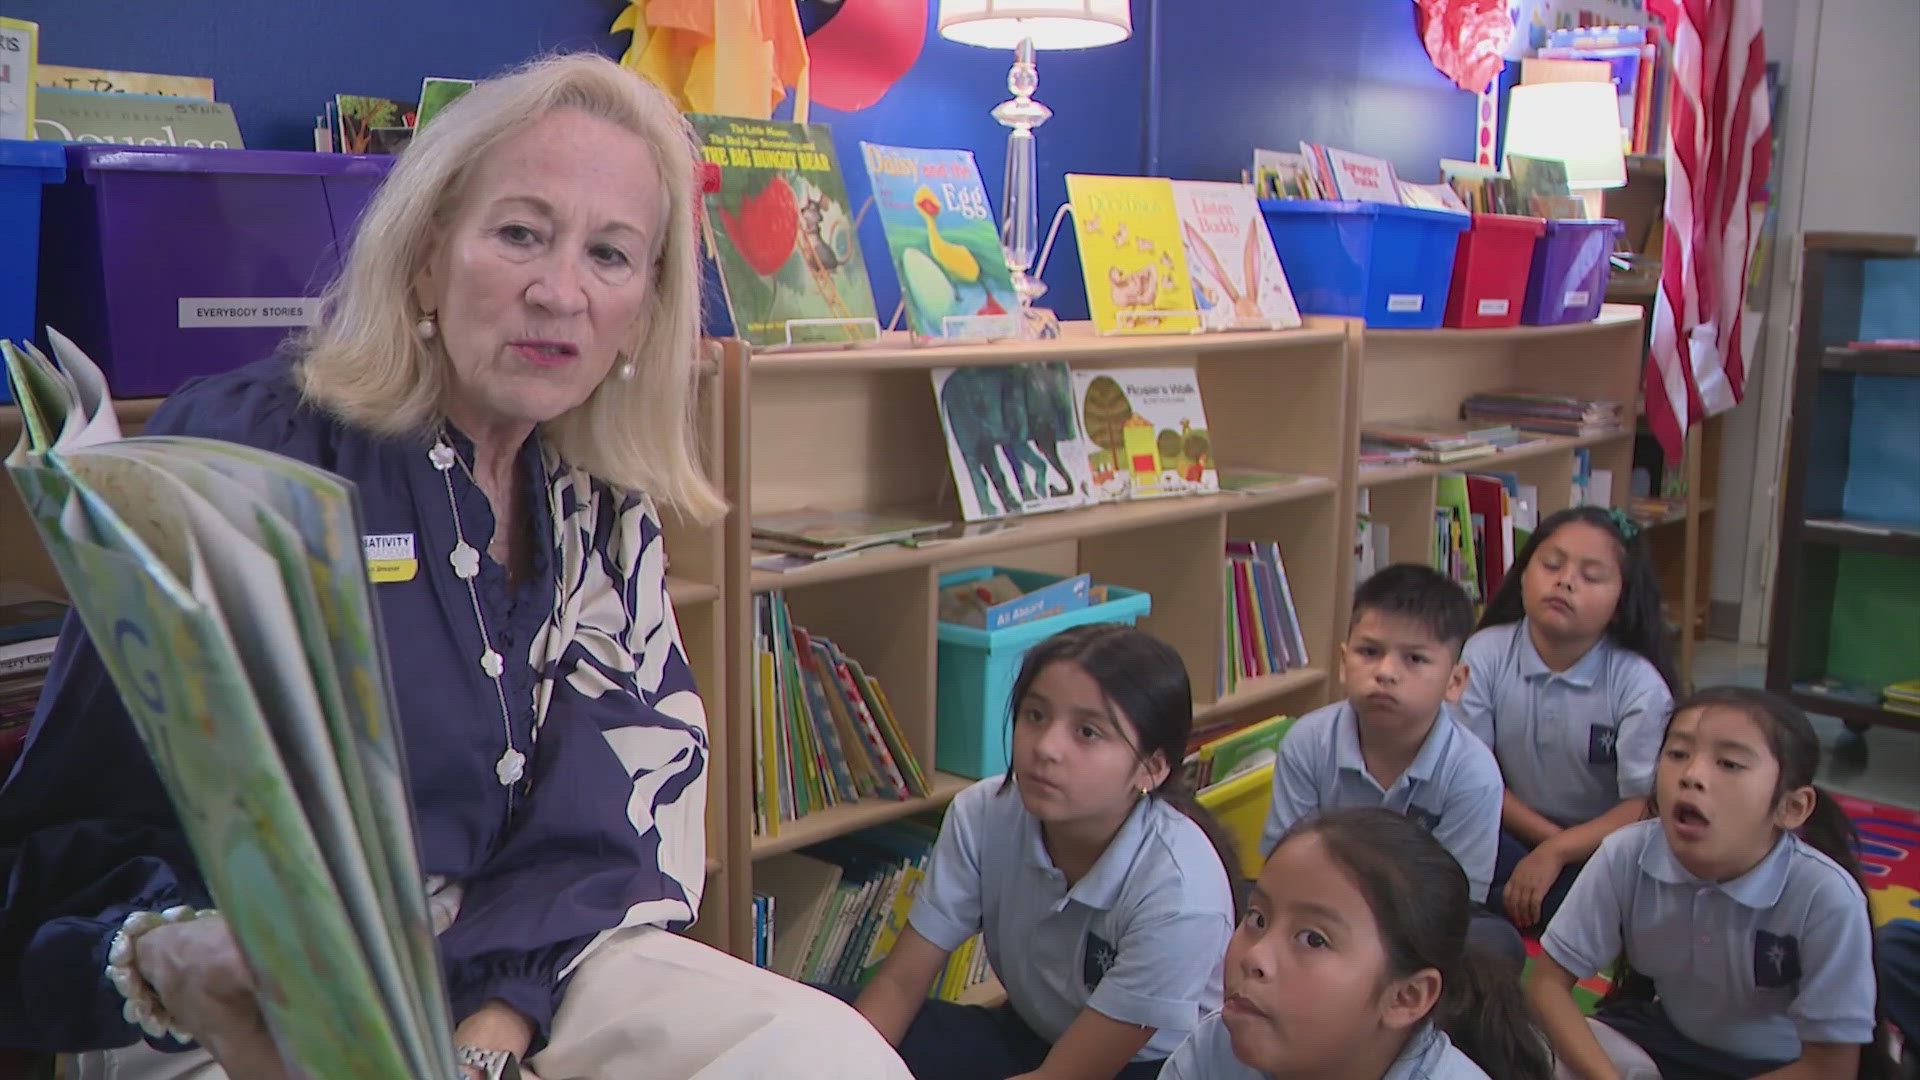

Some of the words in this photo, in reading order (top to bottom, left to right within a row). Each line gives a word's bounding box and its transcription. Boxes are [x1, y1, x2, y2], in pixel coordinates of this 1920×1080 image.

[703, 146, 729, 167] THE
[865, 144, 919, 184] Daisy
[942, 182, 988, 220] Egg
[197, 307, 257, 317] EVERYBODY
[262, 307, 303, 317] STORIES
